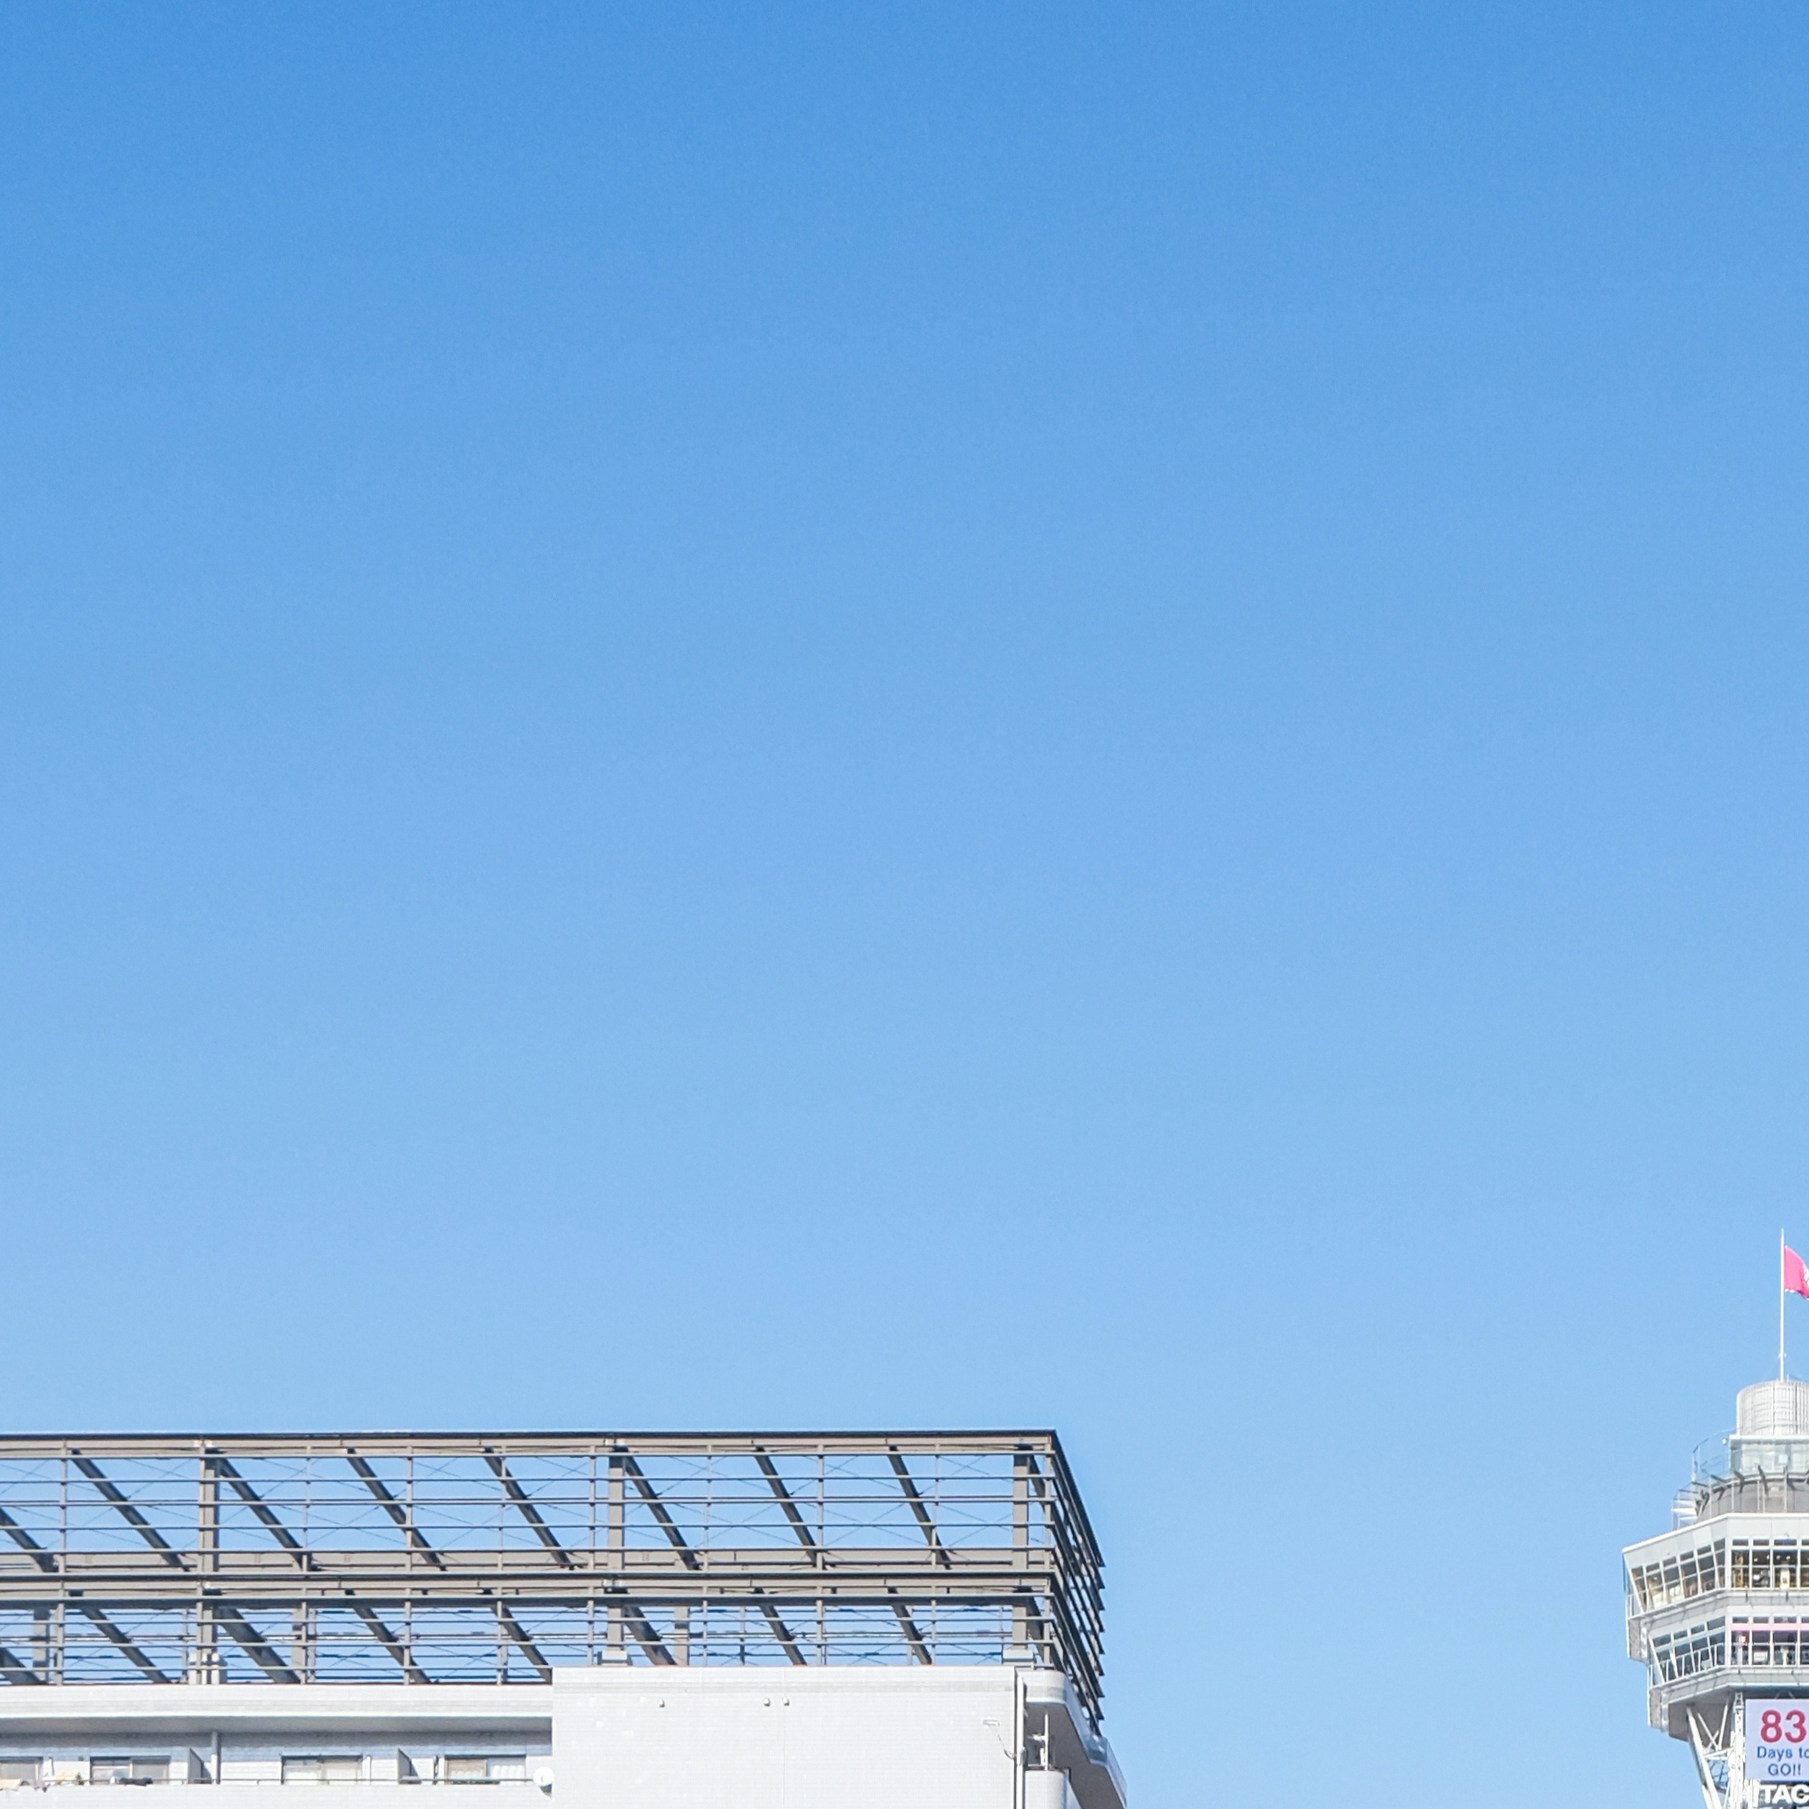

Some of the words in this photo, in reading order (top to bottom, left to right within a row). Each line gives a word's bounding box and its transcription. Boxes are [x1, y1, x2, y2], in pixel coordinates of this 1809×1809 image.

[1760, 1709, 1807, 1743] 83
[1756, 1746, 1793, 1762] Days
[1767, 1763, 1801, 1776] GO!!
